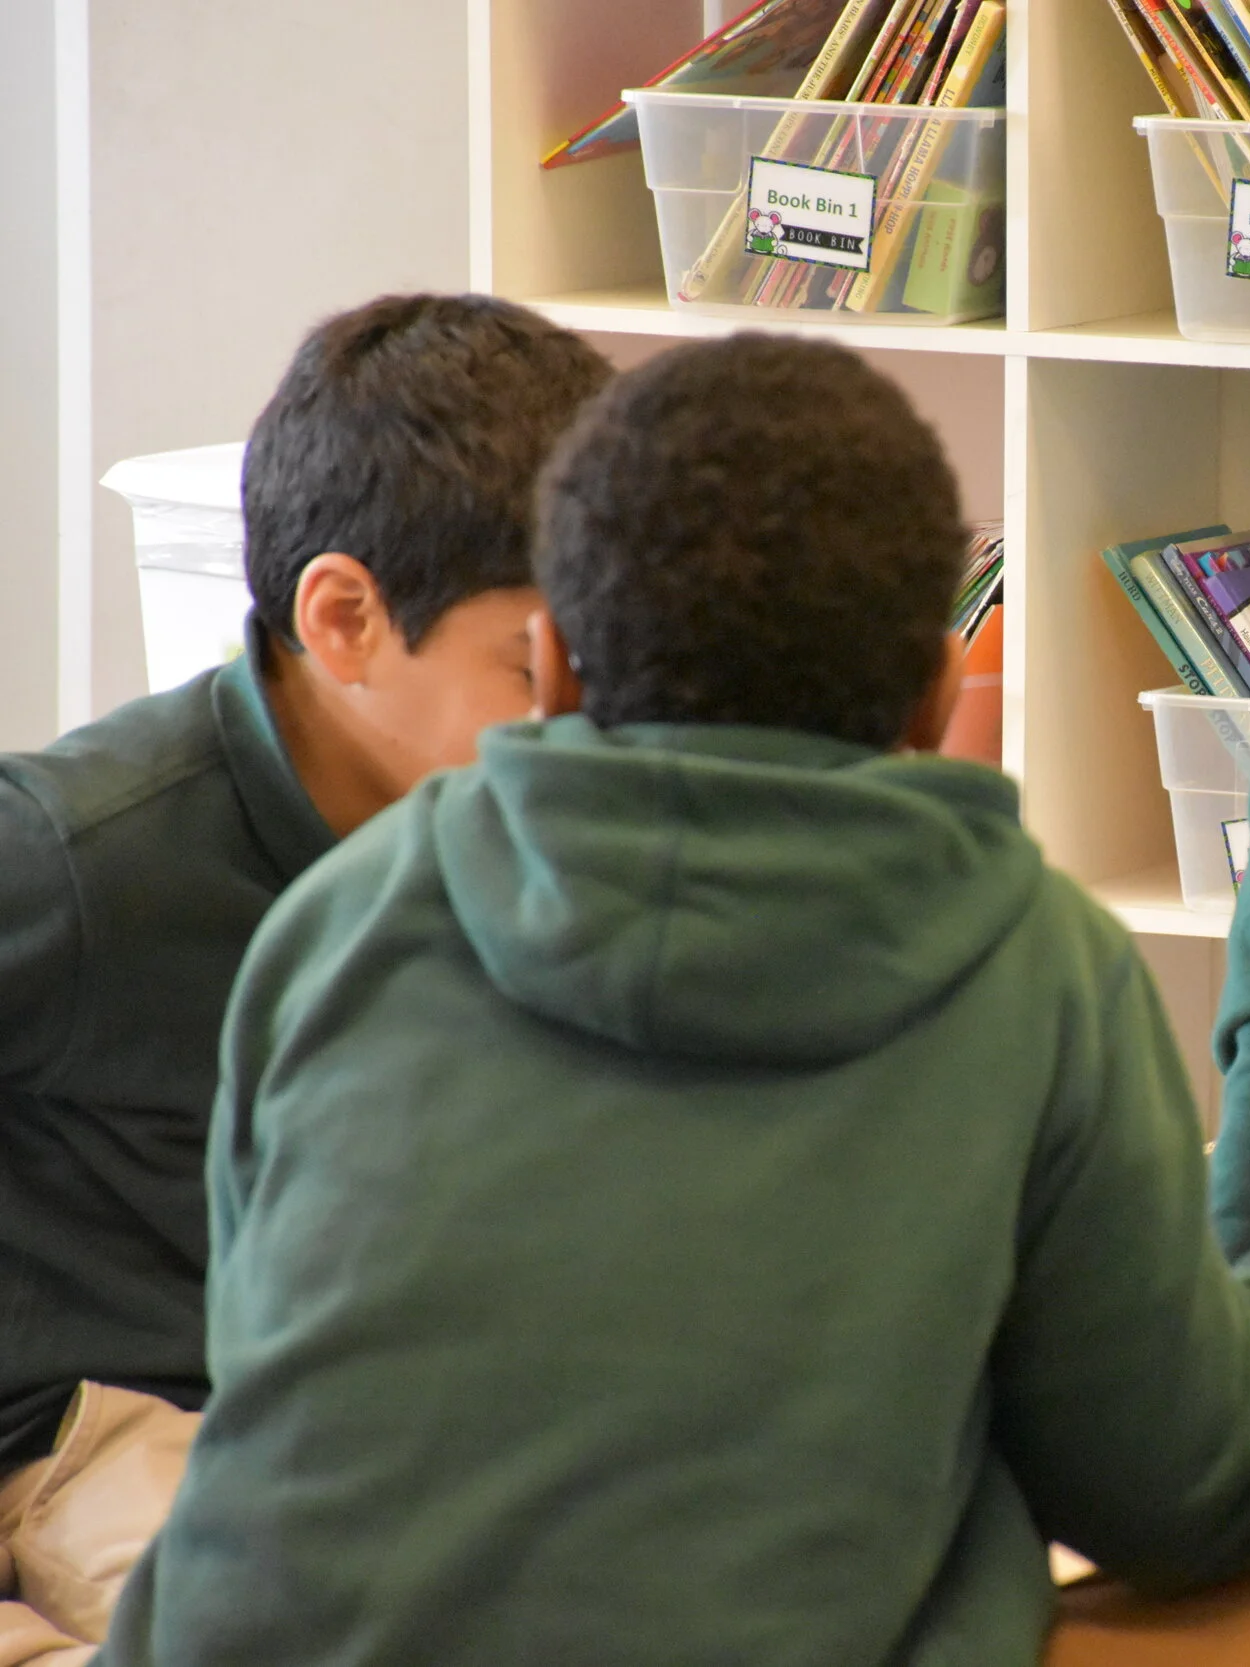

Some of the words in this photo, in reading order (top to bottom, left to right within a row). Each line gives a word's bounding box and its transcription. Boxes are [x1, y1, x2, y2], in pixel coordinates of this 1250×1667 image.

[914, 126, 938, 166] LLAMA
[767, 189, 811, 211] Book
[816, 198, 843, 216] Bin
[848, 203, 858, 219] 1
[788, 228, 822, 244] BOOK
[830, 236, 856, 250] BIN
[1117, 570, 1142, 602] HURD
